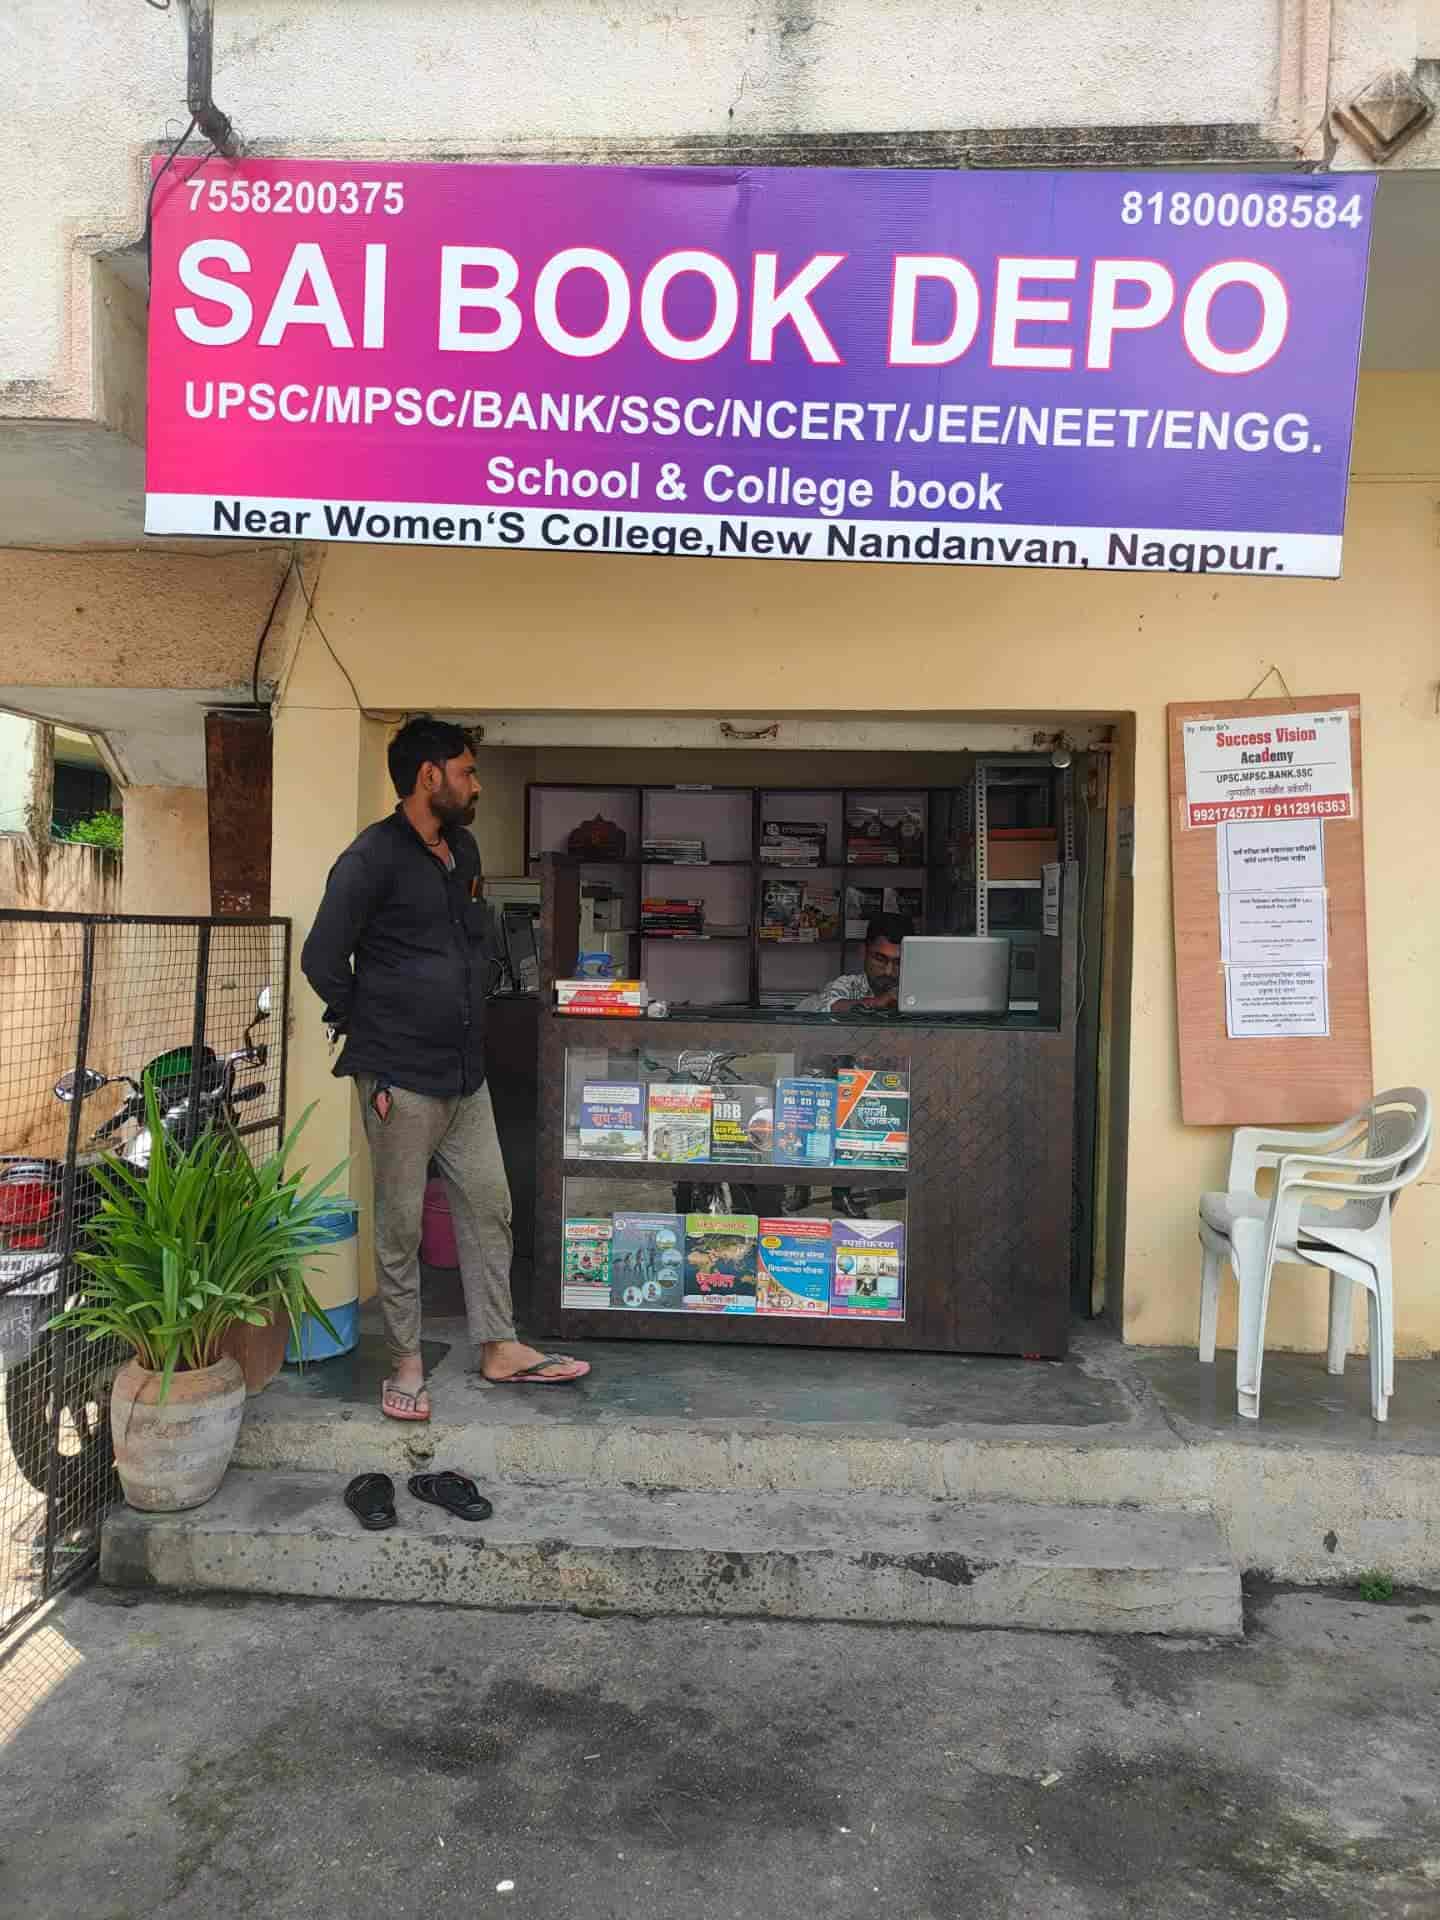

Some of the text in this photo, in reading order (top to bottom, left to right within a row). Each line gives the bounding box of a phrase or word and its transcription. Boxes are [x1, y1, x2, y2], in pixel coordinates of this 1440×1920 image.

[186, 180, 404, 214] 7558200375
[1120, 190, 1364, 230] 8180008584
[174, 239, 1290, 376] SAI BOOK DEPO
[184, 380, 1324, 455] UPSC/MPSC/BANK/SSC/NCERT/JEE/NEET/ENGG.
[486, 456, 1004, 516] School & College book
[213, 500, 311, 534] Near
[826, 526, 1091, 569] Nandanvan,
[1107, 532, 1286, 573] Nagpur.
[1215, 727, 1317, 748] Success Vision
[1240, 747, 1295, 765] Academy
[1193, 804, 1265, 822] 9921745737
